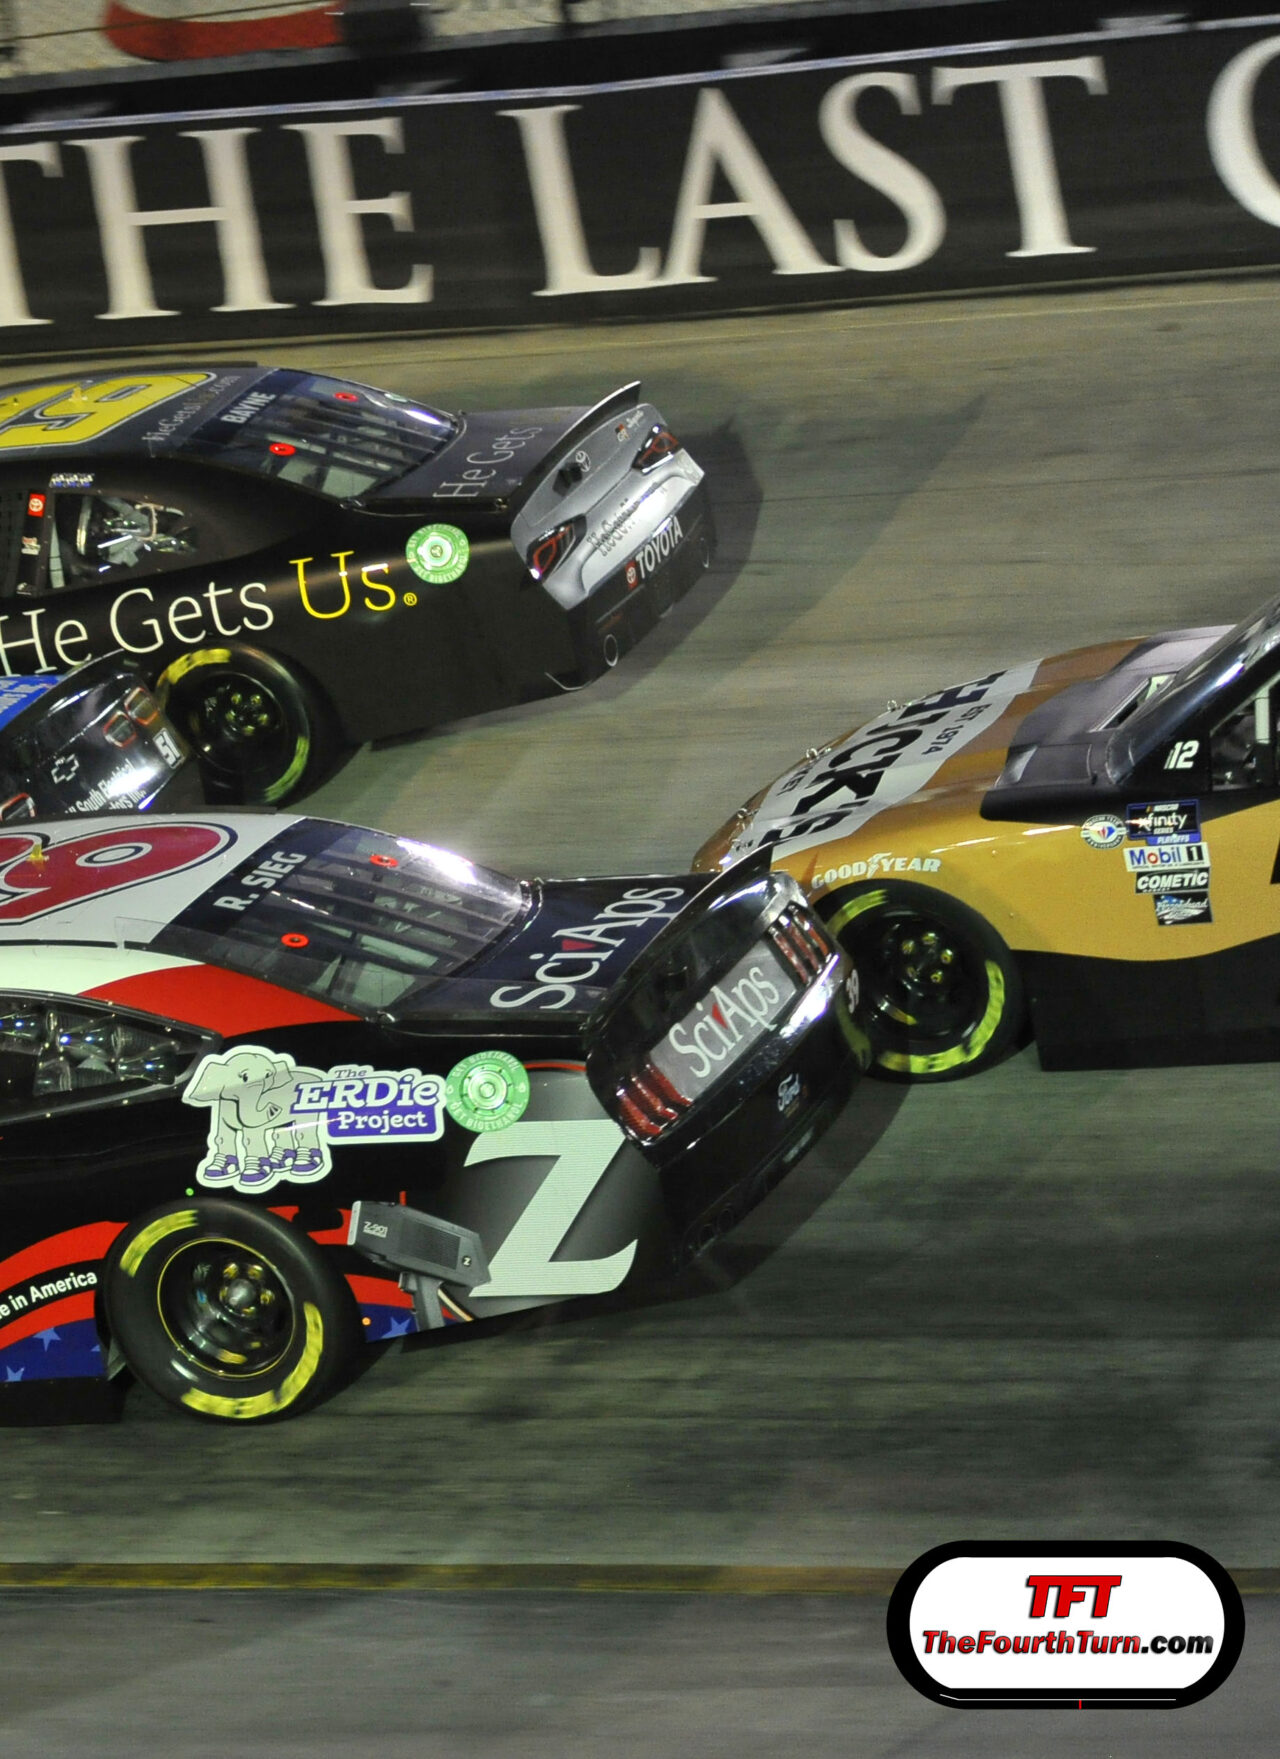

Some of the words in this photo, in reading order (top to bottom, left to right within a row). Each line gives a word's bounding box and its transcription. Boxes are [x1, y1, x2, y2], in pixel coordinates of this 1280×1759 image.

[496, 55, 1110, 297] LAST
[220, 391, 277, 424] BAYNE
[432, 468, 497, 499] He
[466, 427, 544, 464] Gets
[634, 515, 684, 580] TOYOTA
[110, 581, 275, 654] Gets
[1166, 740, 1200, 769] 12
[213, 893, 261, 911] R.
[241, 851, 308, 889] SIEG
[1129, 846, 1182, 866] Mobil
[1137, 869, 1209, 890] COMETIC
[489, 887, 685, 1010] SciAps
[668, 965, 780, 1078] SciAps
[293, 1073, 440, 1112] ERDie
[334, 1069, 368, 1079] The
[337, 1109, 428, 1134] Project
[463, 1119, 639, 1298] Z
[8, 1294, 29, 1311] in
[29, 1271, 98, 1303] America
